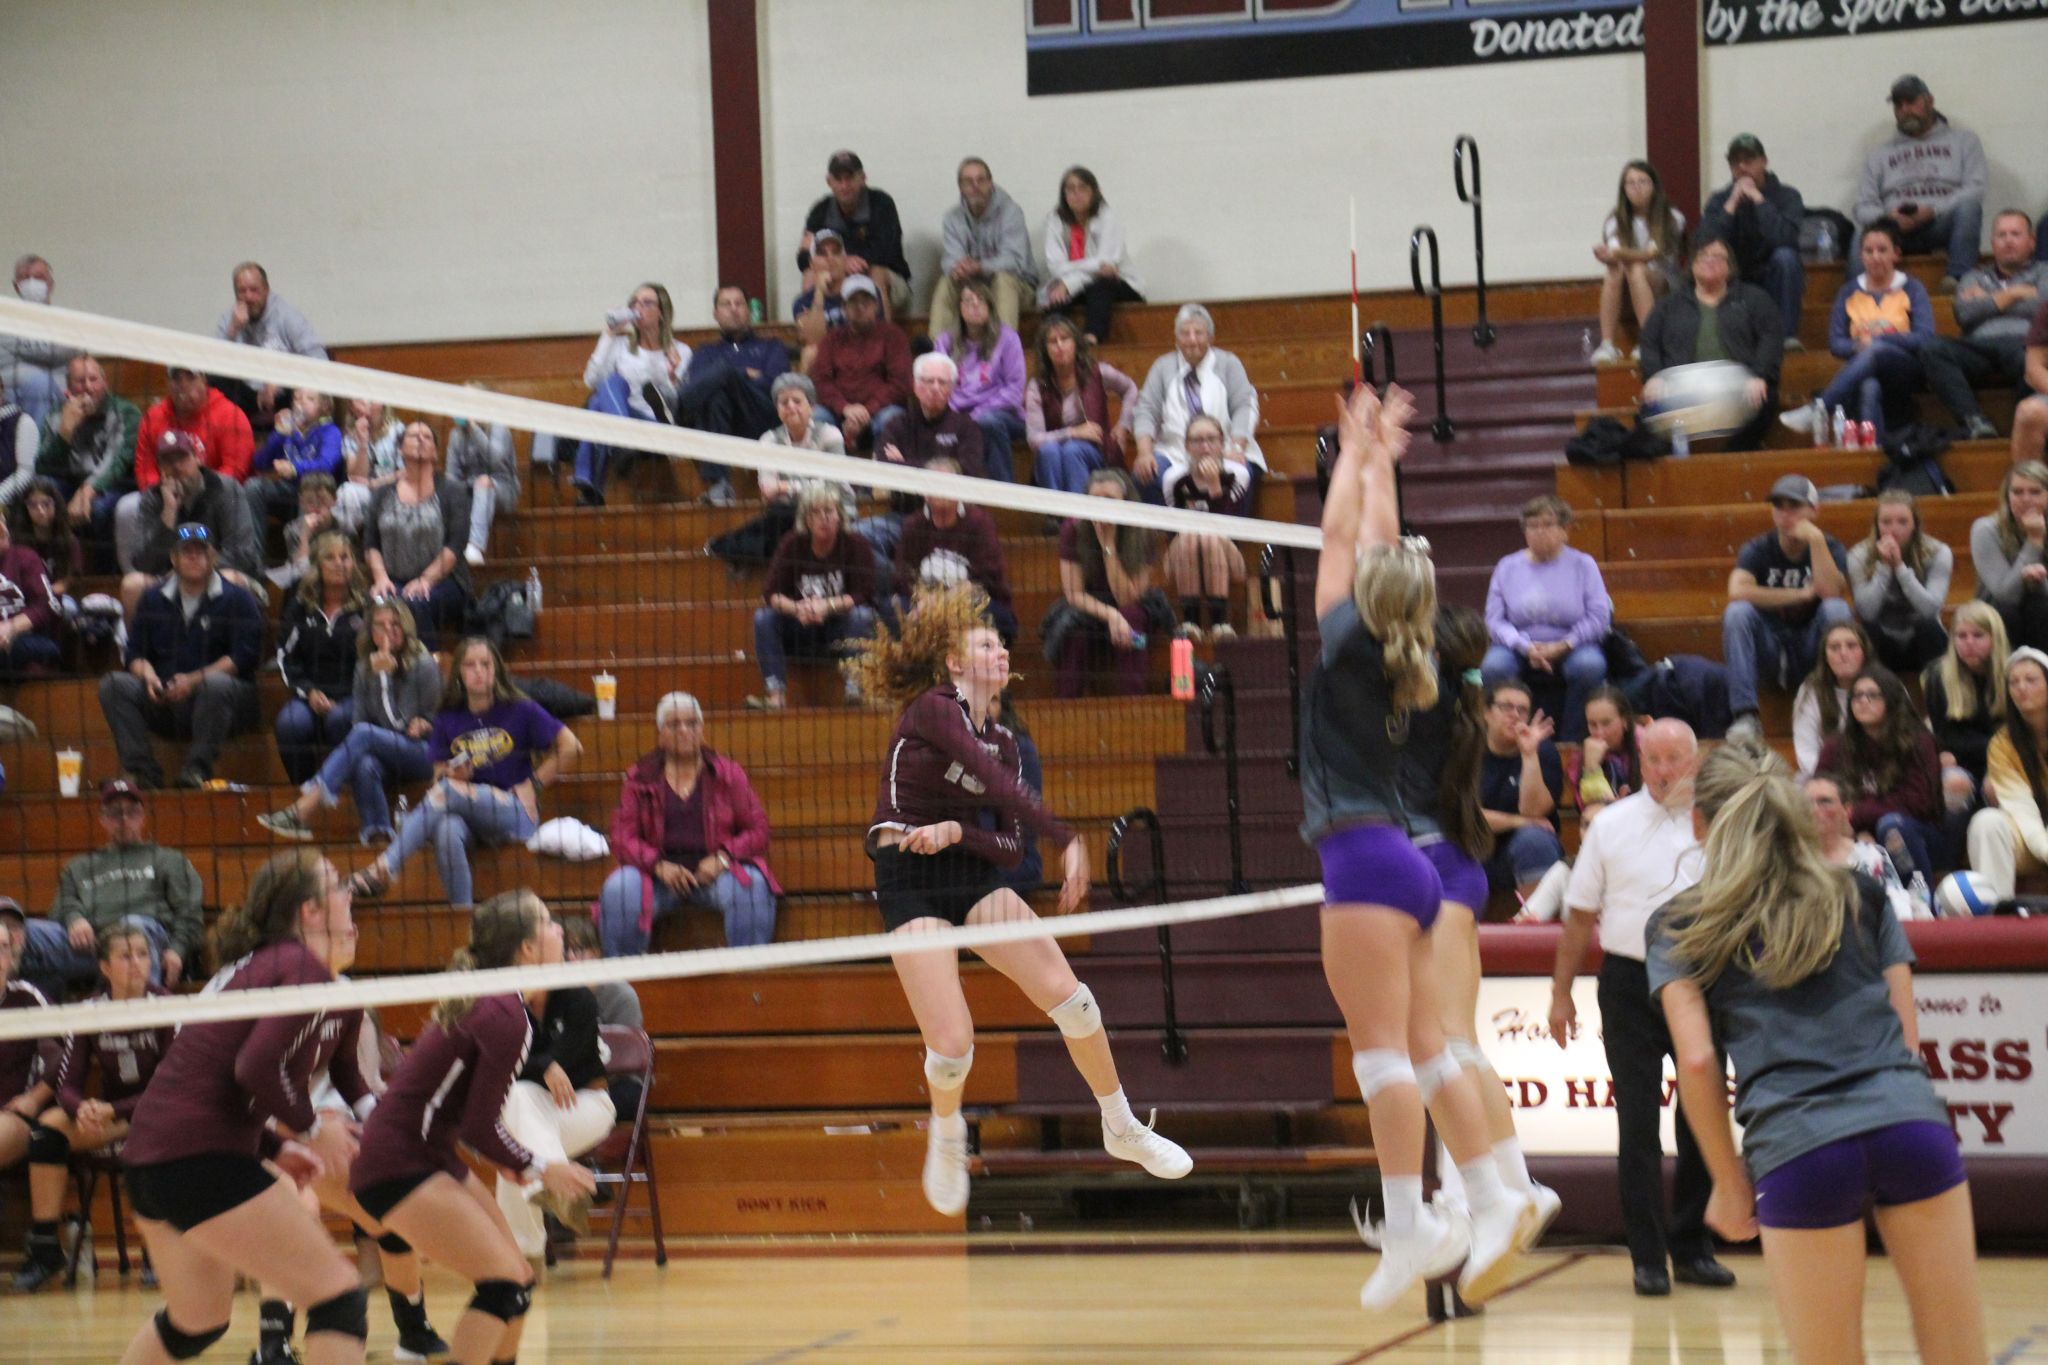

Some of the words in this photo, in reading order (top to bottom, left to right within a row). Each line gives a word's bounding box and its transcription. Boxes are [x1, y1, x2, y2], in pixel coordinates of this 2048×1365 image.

[1470, 6, 1645, 57] Donated
[1705, 0, 1747, 44] by
[1756, 0, 1824, 34] the
[788, 1197, 828, 1212] KICK
